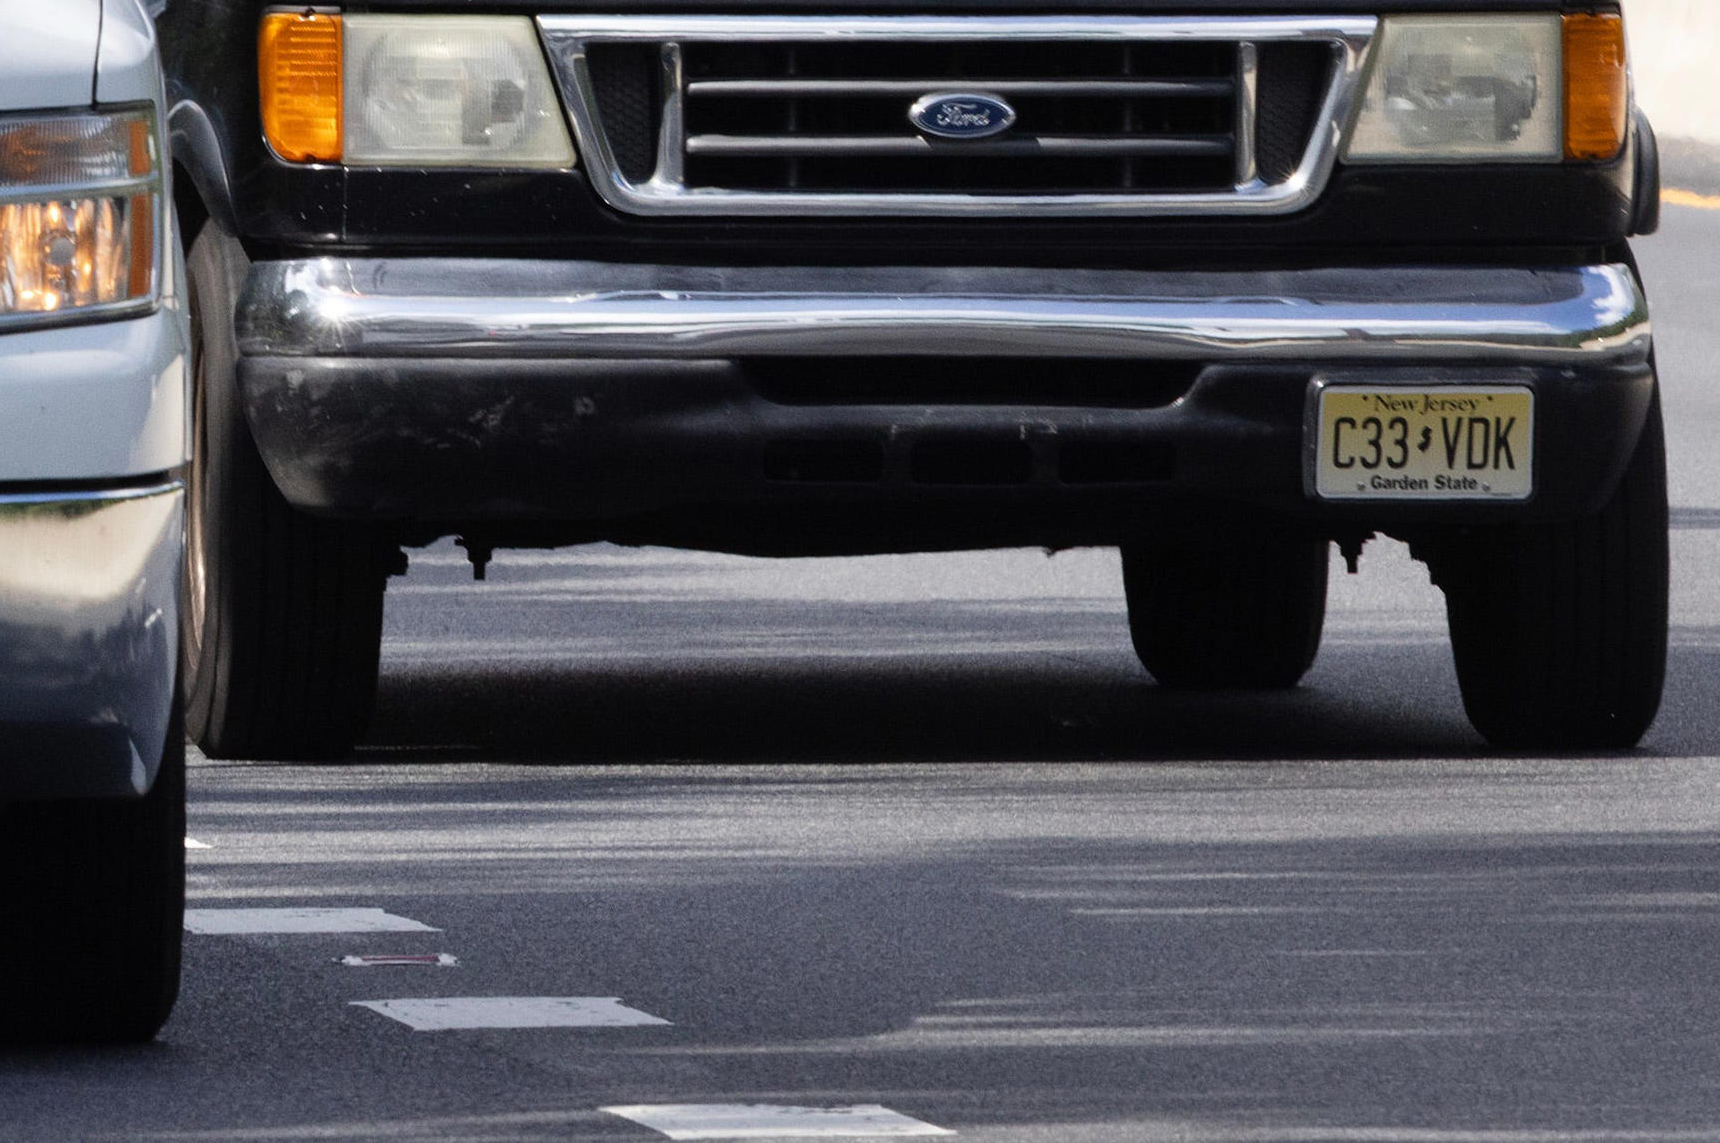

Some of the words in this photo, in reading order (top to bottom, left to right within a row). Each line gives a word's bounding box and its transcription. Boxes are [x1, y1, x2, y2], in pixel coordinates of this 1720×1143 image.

[1374, 394, 1419, 412] New
[1420, 394, 1480, 416] Jersey
[1333, 416, 1409, 469] C33
[1441, 416, 1516, 470] VDK
[1371, 475, 1428, 491] Garden
[1435, 475, 1478, 491] State
